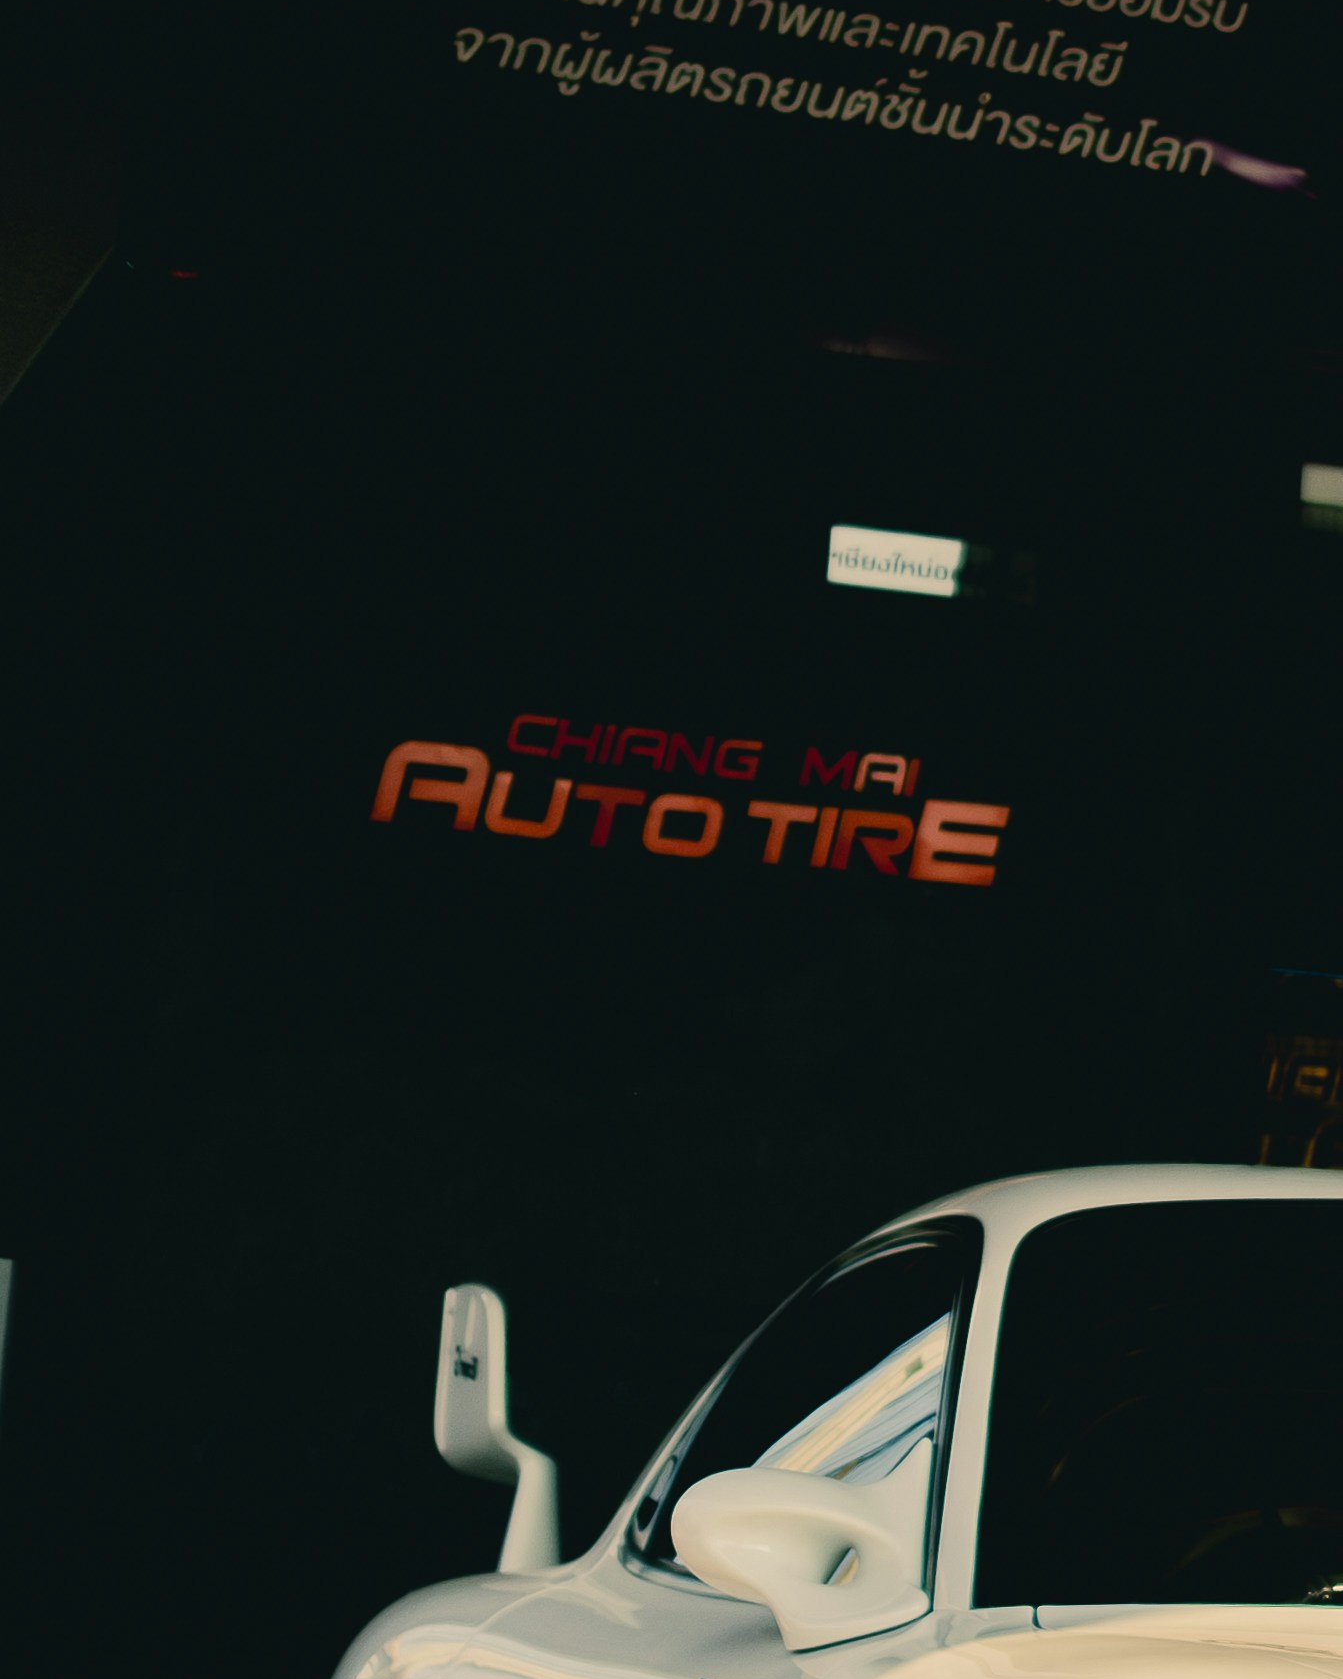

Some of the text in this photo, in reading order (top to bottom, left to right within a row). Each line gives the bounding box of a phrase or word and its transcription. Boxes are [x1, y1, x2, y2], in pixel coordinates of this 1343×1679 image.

[453, 25, 1215, 176] จากผู้ผลิตรถยนต์ชั้นนำระดับโลก
[369, 739, 1012, 888] AUTO TIRE
[506, 713, 921, 798] CHIANG MAI
